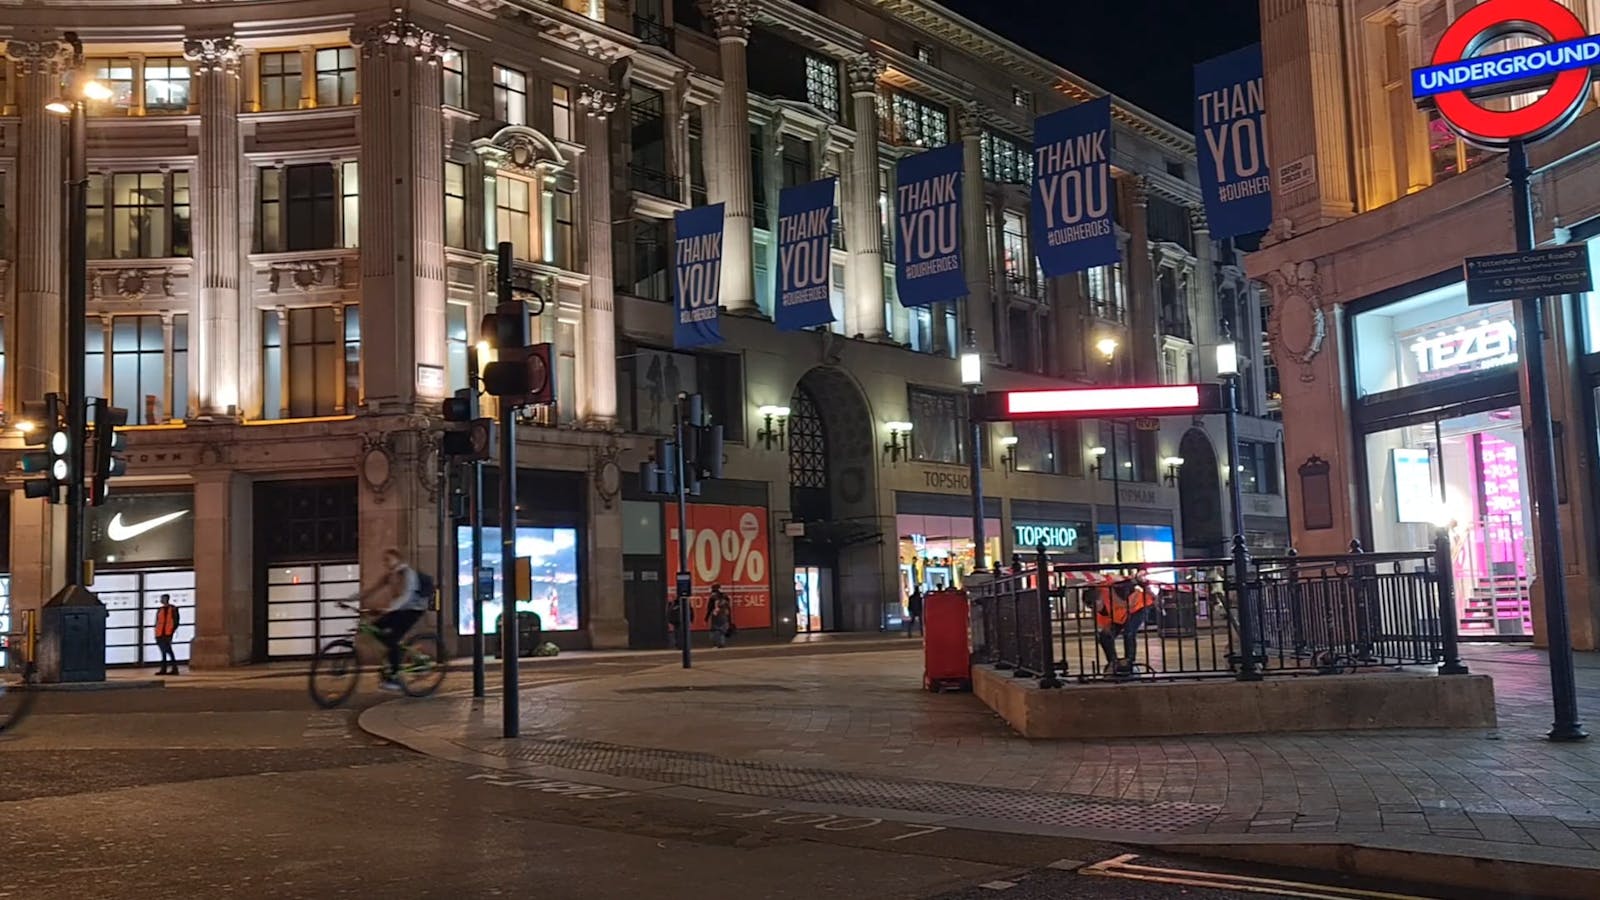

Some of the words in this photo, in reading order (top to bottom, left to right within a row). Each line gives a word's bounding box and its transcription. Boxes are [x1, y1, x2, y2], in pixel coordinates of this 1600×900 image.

[1420, 42, 1600, 89] UNDERGROUND
[1198, 77, 1264, 126] THAN
[1036, 128, 1106, 176] THANK
[898, 171, 958, 214] THANK
[1038, 163, 1108, 228] YOU
[1219, 176, 1271, 202] #OURHER
[780, 206, 831, 244] THANK
[900, 203, 957, 263] YOU
[1048, 218, 1110, 247] #OURHEROES
[676, 232, 721, 264] THANK
[780, 237, 829, 291] YOU
[906, 254, 958, 280] #OURHEROES
[1522, 254, 1545, 263] Court
[677, 260, 720, 309] YOU
[783, 285, 827, 306] #OURHEROES
[1410, 320, 1518, 373] TEZEN
[923, 471, 969, 489] TOPSHO
[670, 512, 764, 582] 70%
[1016, 525, 1077, 547] TOPSHOP
[744, 595, 765, 607] SALE
[716, 807, 946, 842] LOOK
